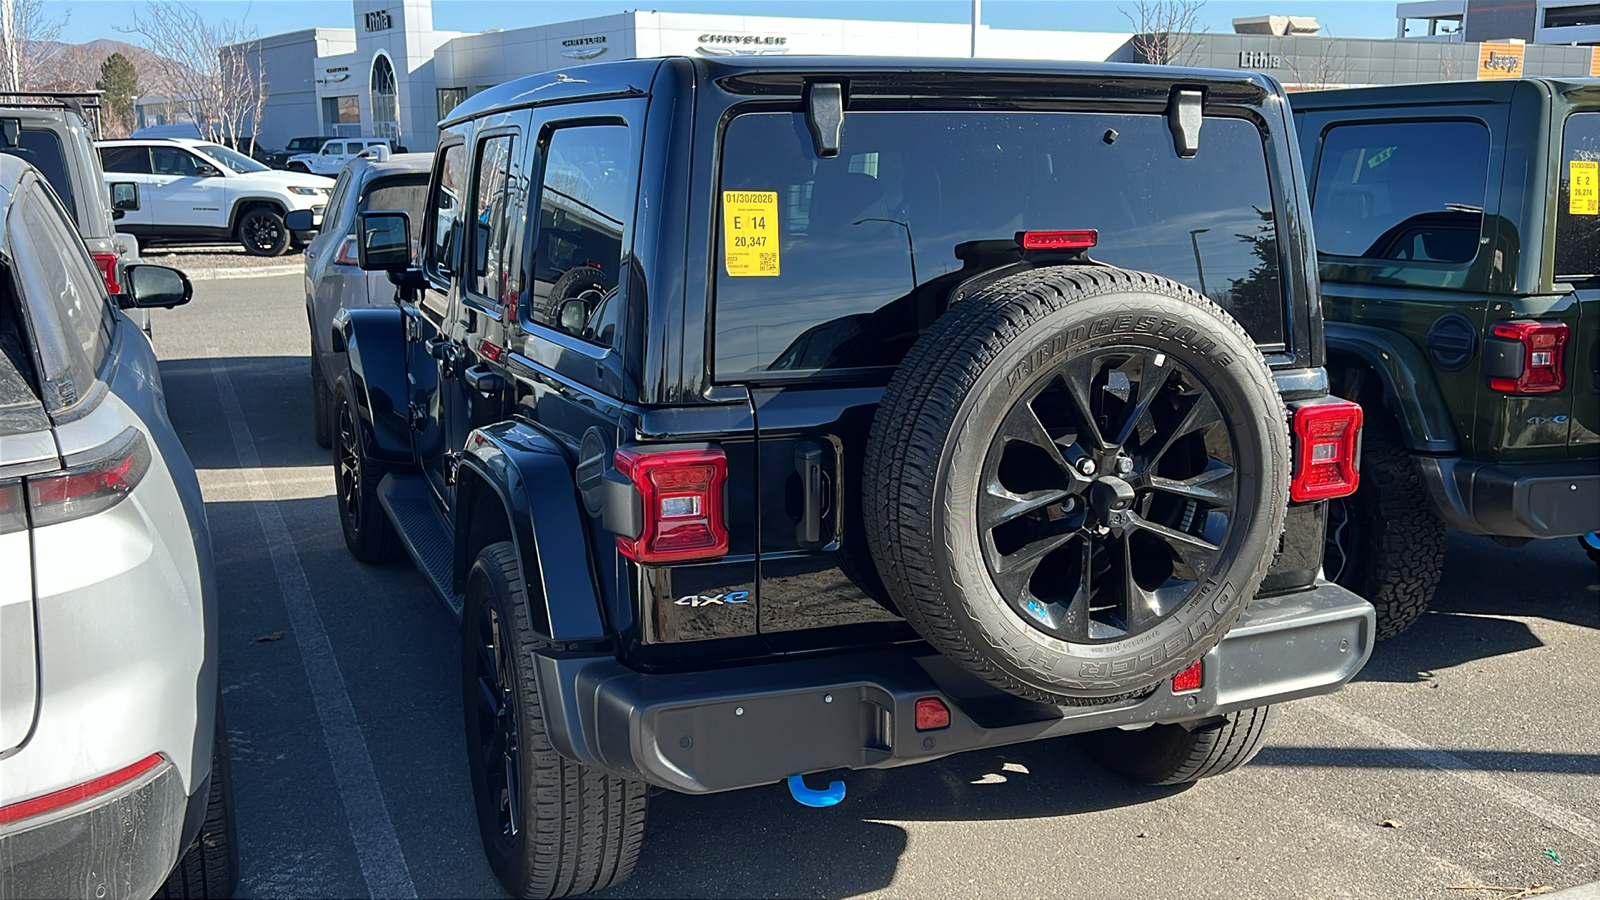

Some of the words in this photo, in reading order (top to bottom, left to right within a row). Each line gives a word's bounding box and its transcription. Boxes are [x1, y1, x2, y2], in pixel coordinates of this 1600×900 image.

[365, 10, 392, 32] Lithia
[698, 34, 787, 45] CHRYSLER
[1239, 51, 1281, 69] Lithia
[1484, 51, 1519, 73] Jeep
[1576, 176, 1582, 185] E
[1585, 176, 1590, 185] 2
[726, 193, 773, 203] 01/30/2026
[734, 216, 742, 230] E
[751, 216, 766, 230] 14
[735, 236, 767, 248] 20,347
[1006, 314, 1236, 396] BRIDGESTONE
[1078, 580, 1237, 681] DUELER
